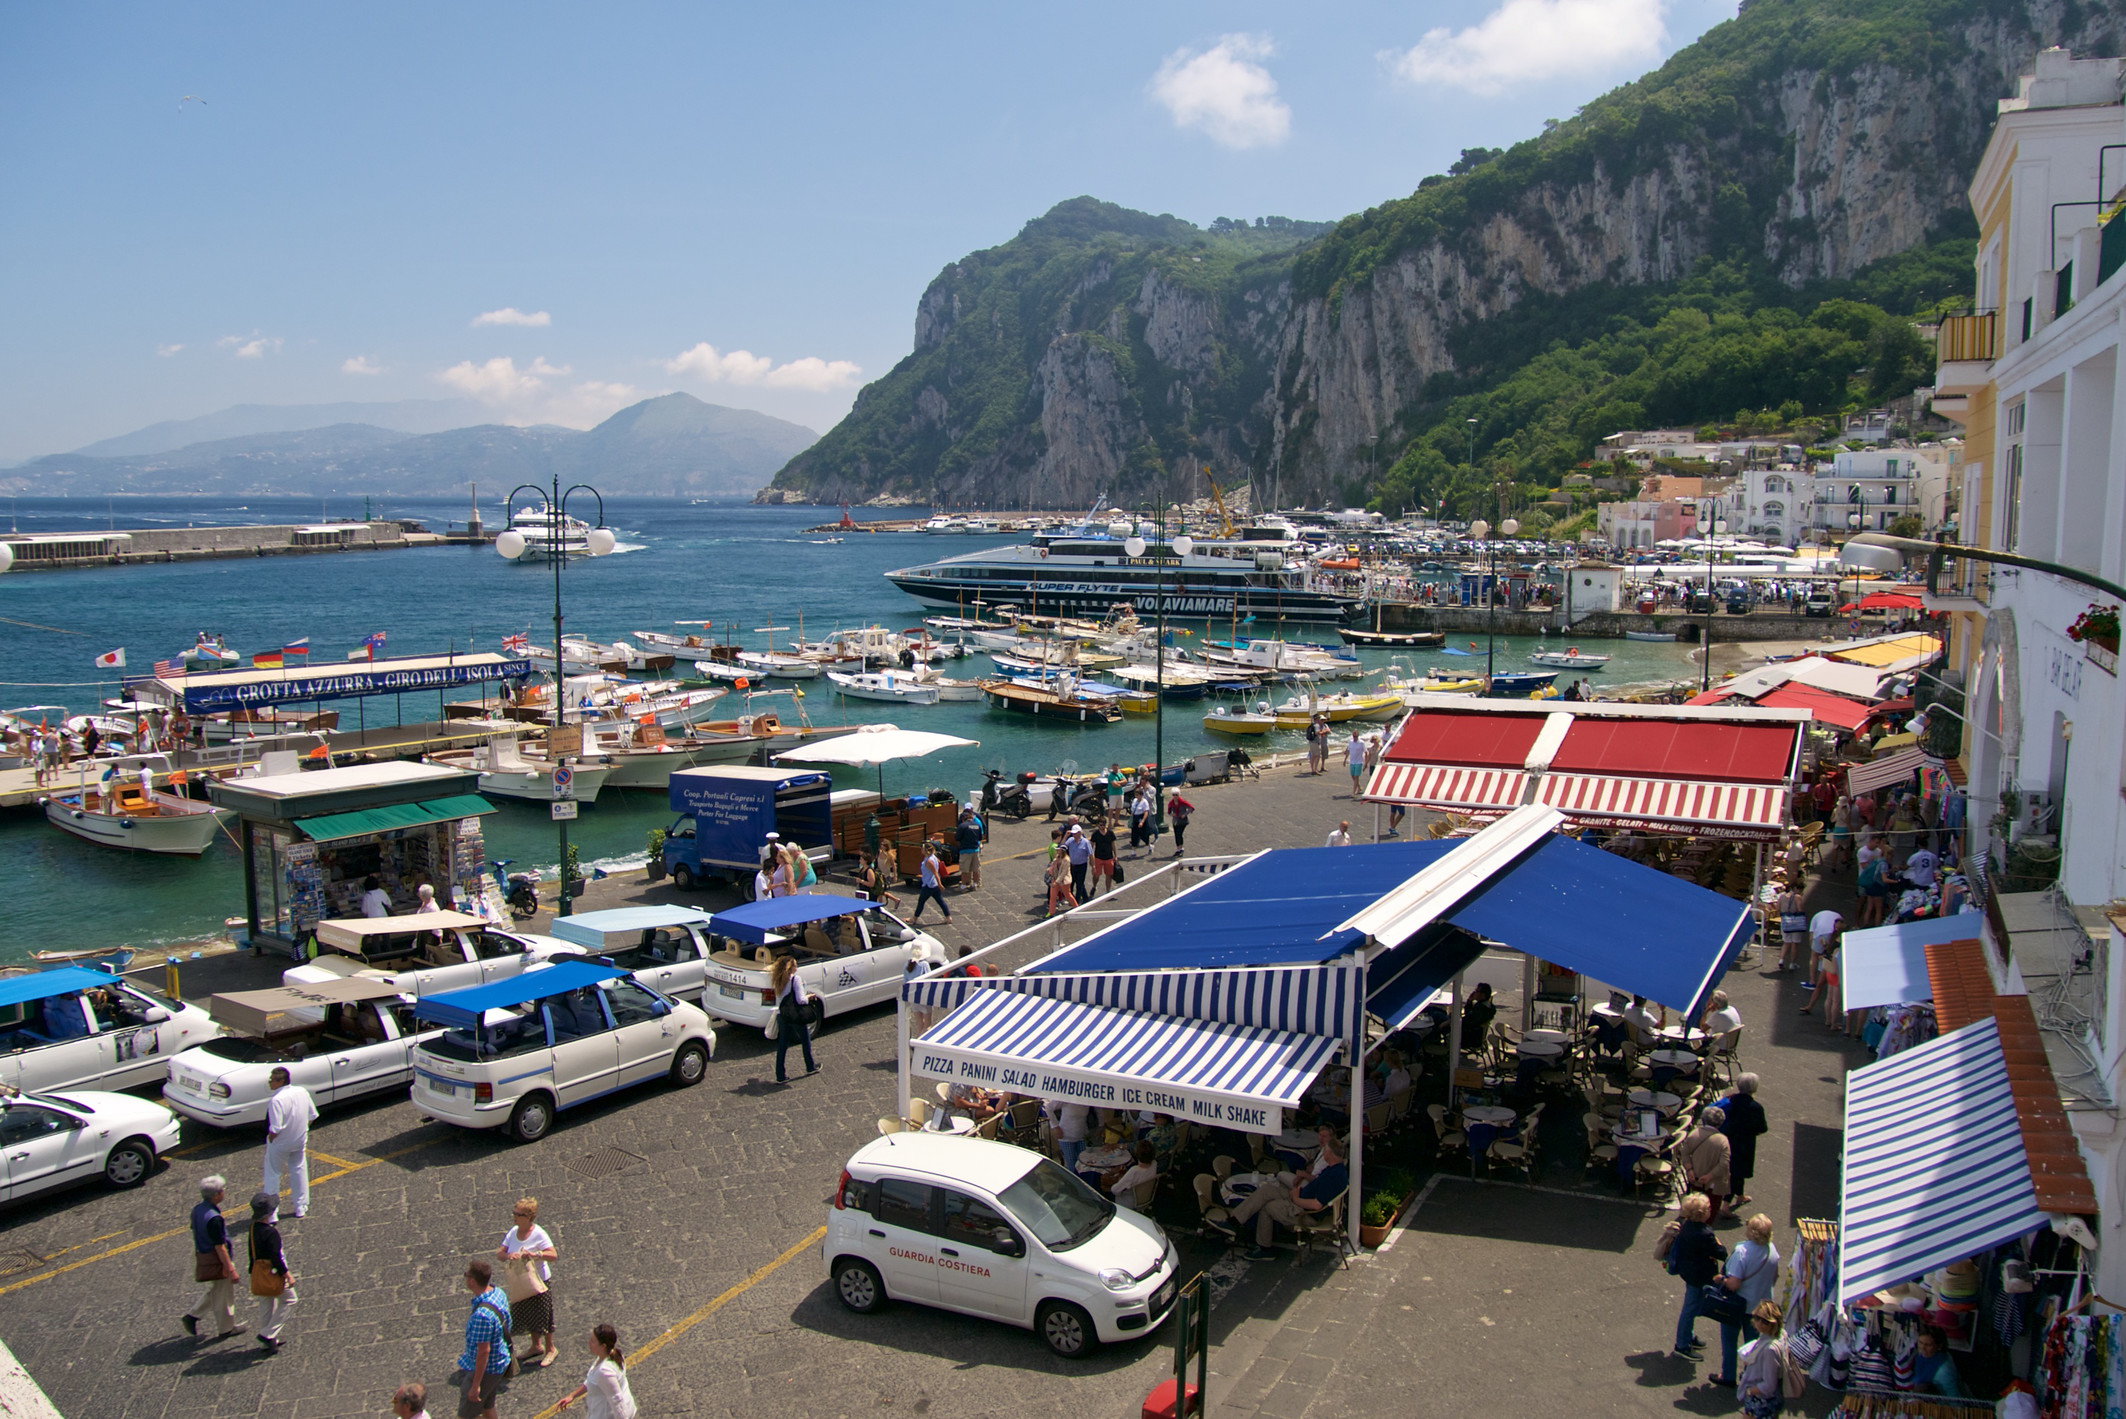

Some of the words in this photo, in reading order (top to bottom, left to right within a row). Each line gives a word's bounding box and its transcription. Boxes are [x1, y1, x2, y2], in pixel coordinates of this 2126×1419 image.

[1029, 582, 1074, 591] SUPER
[1077, 583, 1119, 592] FLYTE
[236, 679, 302, 701] GROTTA
[305, 675, 375, 696] AZZURRA
[385, 671, 421, 688] GIRO
[424, 668, 462, 685] DELL'
[466, 665, 504, 682] ISOLA
[504, 662, 527, 672] SINCE
[684, 788, 702, 798] Coop.
[703, 790, 729, 800] Portuali
[730, 792, 755, 803] Capresi
[714, 801, 735, 811] Bagagli
[740, 804, 759, 812] Merce
[697, 809, 714, 817] Porter
[714, 810, 724, 818] For
[725, 811, 748, 821] Luggage
[1579, 816, 1611, 827] GRANITE
[1616, 818, 1642, 829] GELATI
[1648, 821, 1668, 831] MILK
[1668, 823, 1695, 834] SHAKE
[1921, 858, 1930, 868] 3
[729, 973, 747, 984] 1414
[922, 1056, 953, 1075] PIZZA
[960, 1061, 997, 1082] PANINI
[1001, 1068, 1037, 1089] SALAD
[1041, 1075, 1115, 1101] HAMBURGER
[1122, 1088, 1142, 1104] ICE
[1146, 1091, 1185, 1112] CREAM
[1193, 1100, 1222, 1119] MILK
[1227, 1105, 1266, 1127] SHAKE
[889, 1247, 935, 1264] GUARDIA
[938, 1258, 991, 1278] COSTIERA
